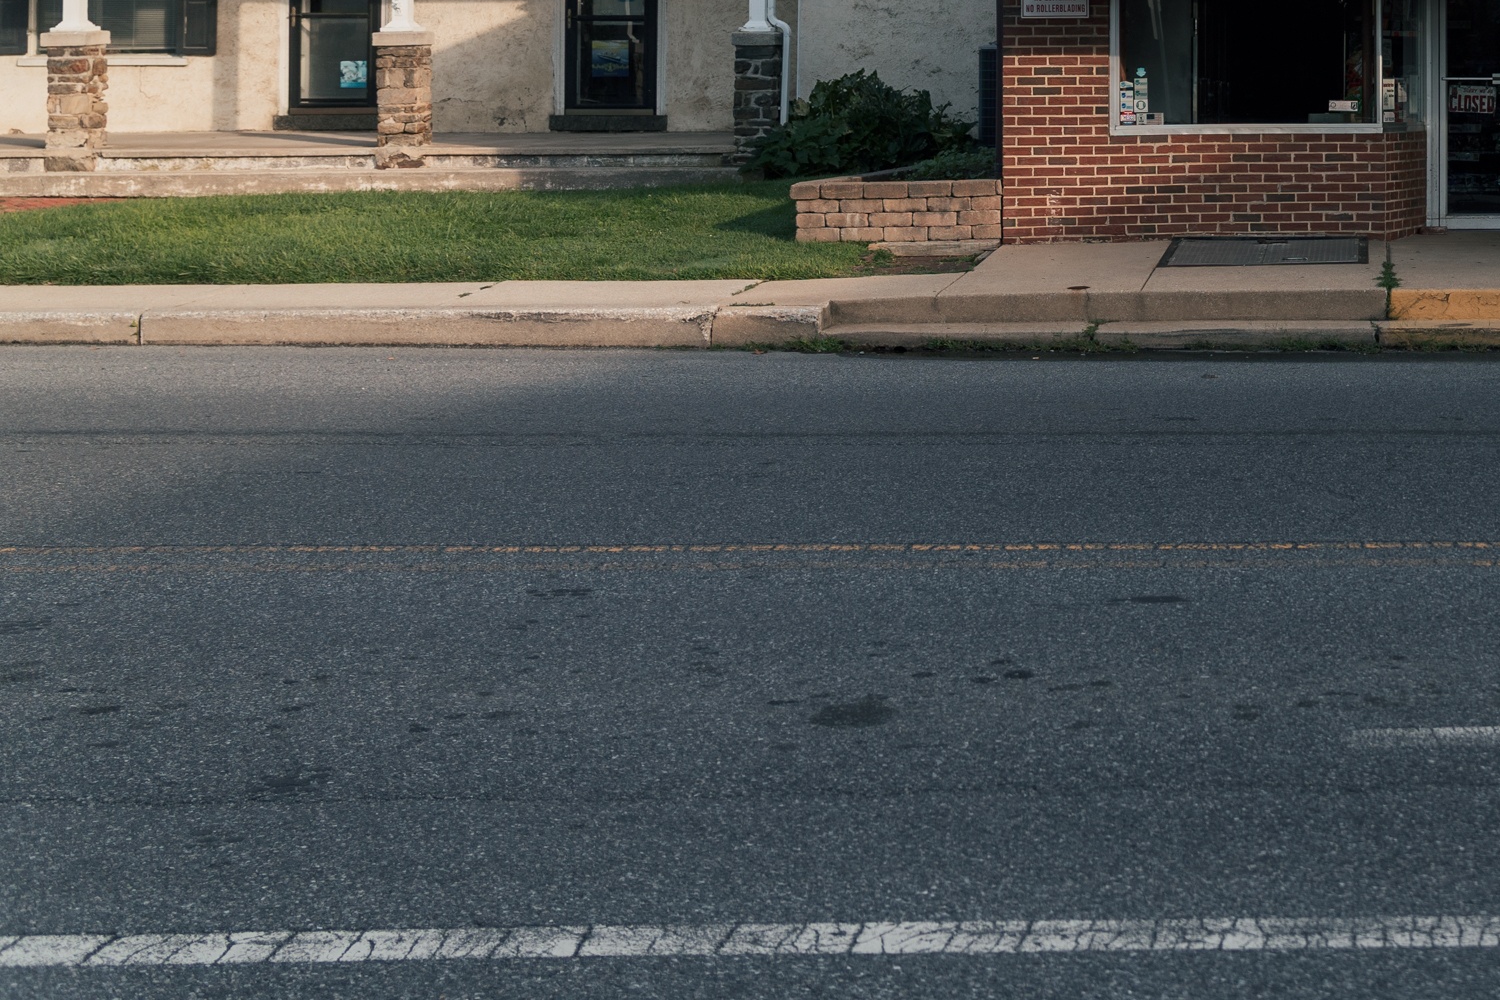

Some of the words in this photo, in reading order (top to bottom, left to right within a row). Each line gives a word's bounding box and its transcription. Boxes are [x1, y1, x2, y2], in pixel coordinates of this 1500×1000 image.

[1026, 4, 1034, 12] NO
[1037, 4, 1086, 12] ROLLERBLADING
[1449, 94, 1495, 112] CLOSED
